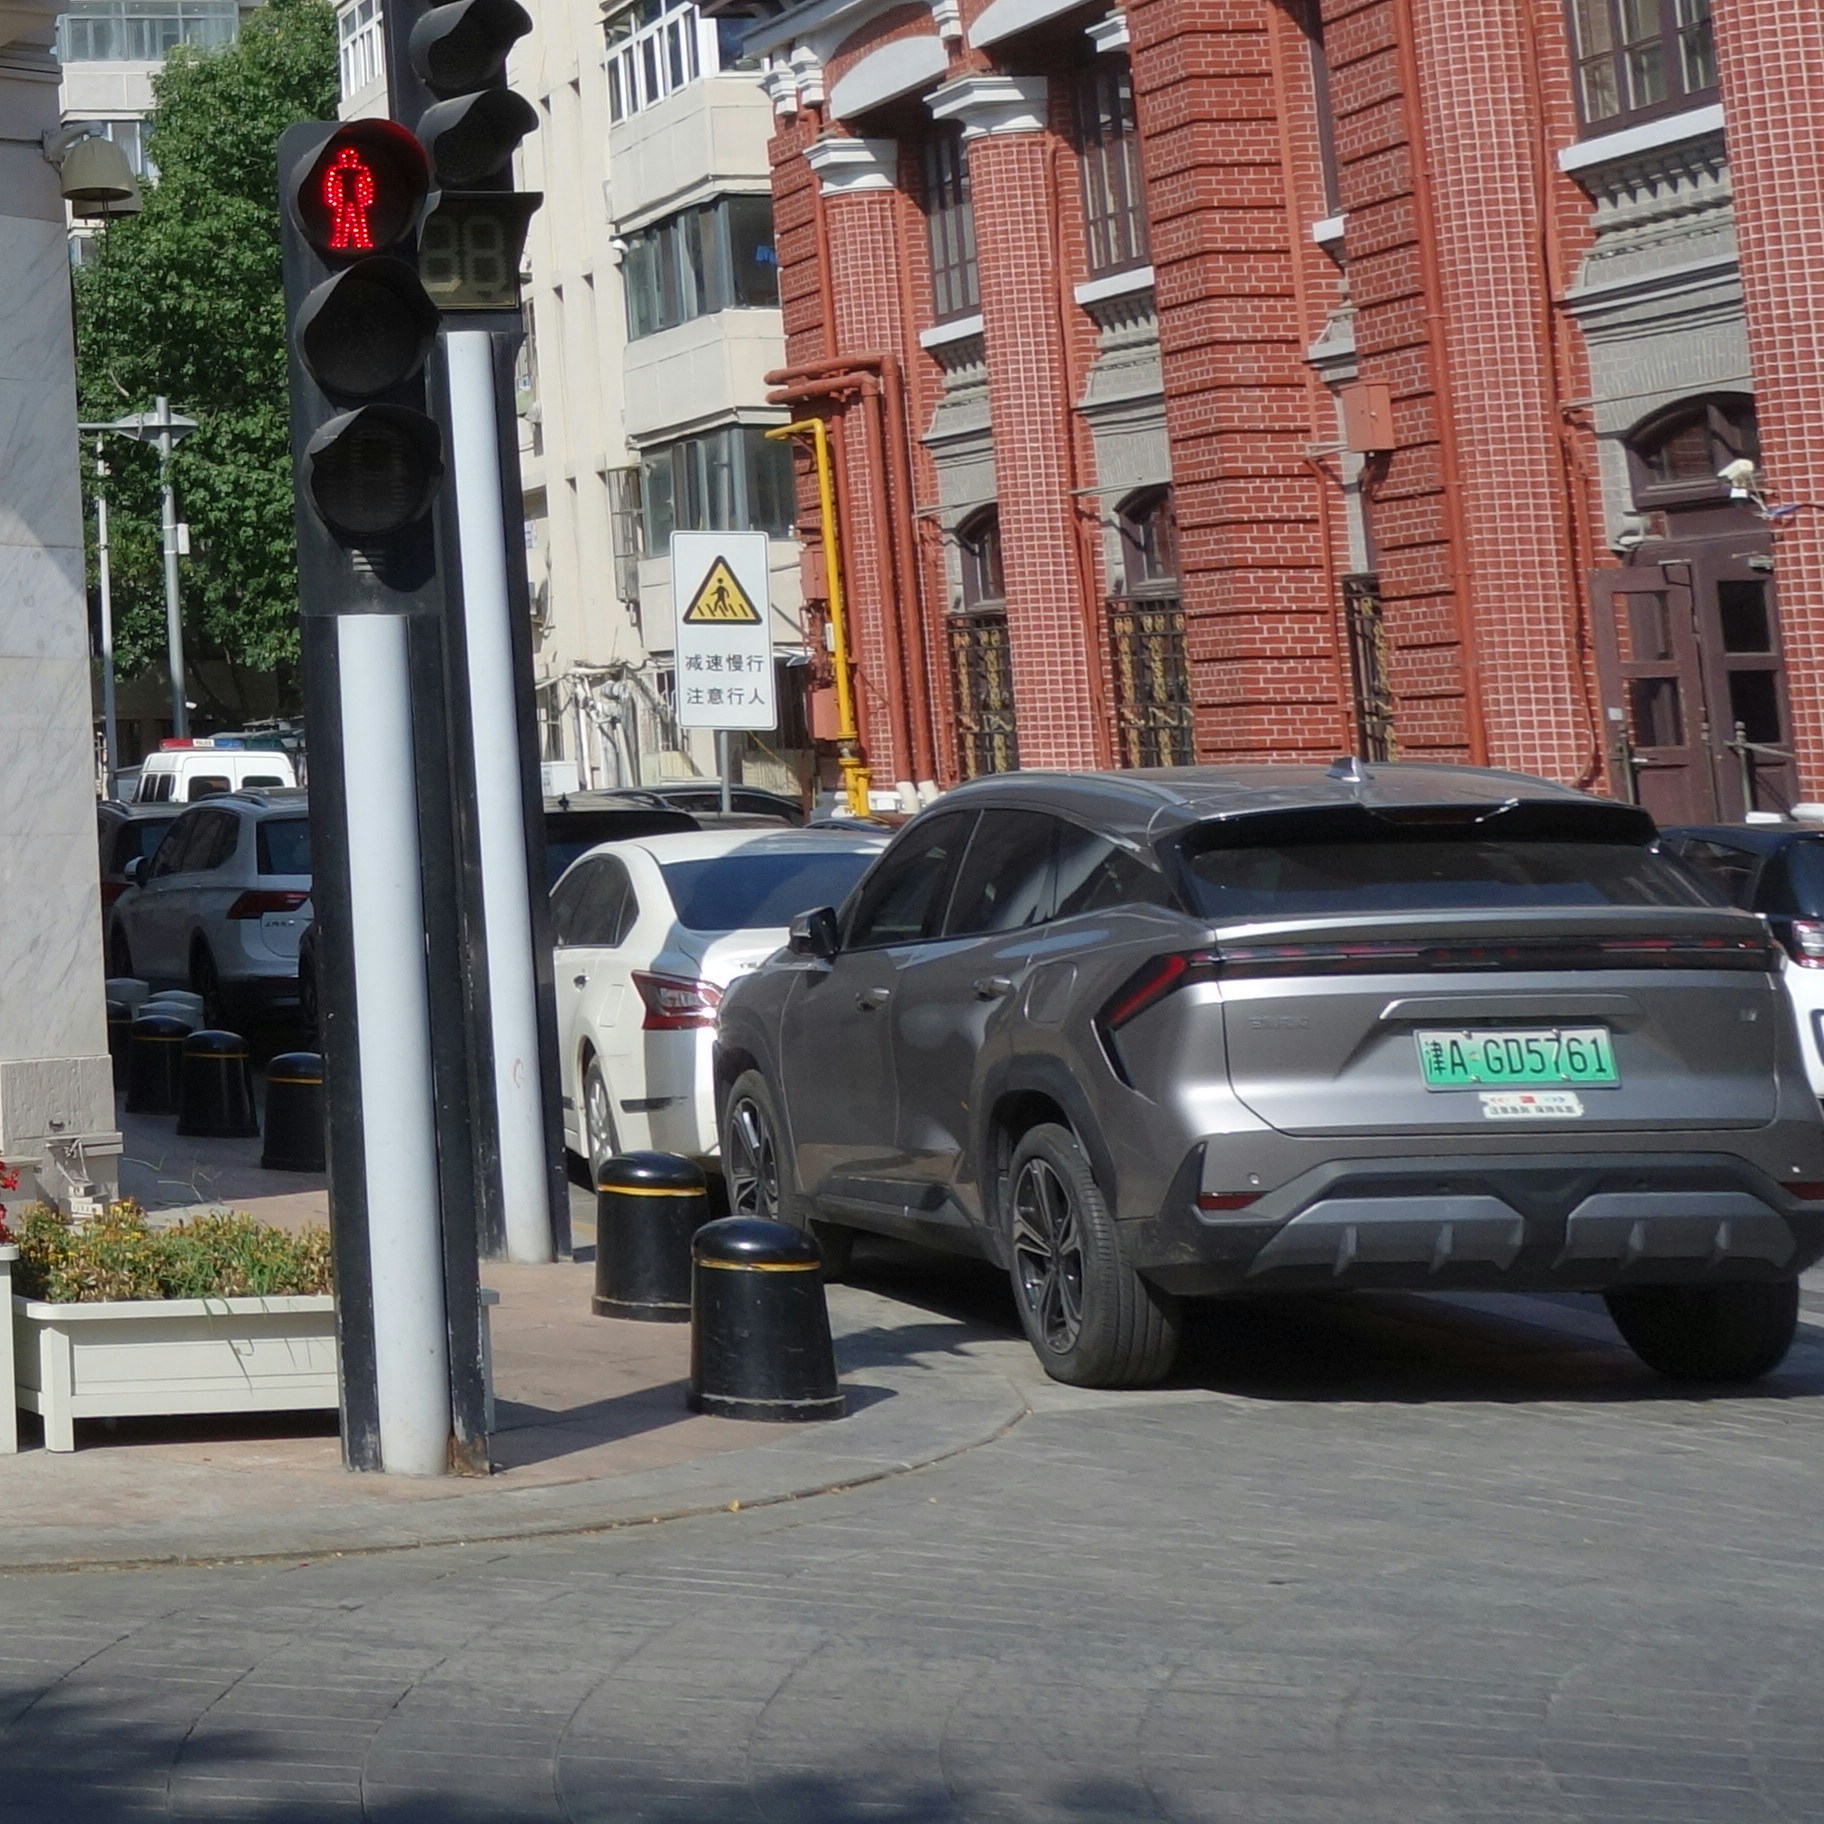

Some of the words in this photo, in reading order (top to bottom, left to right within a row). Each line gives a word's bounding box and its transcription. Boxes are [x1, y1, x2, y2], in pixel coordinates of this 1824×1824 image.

[684, 653, 766, 673] 减速慢行
[686, 686, 766, 706] 注意行人
